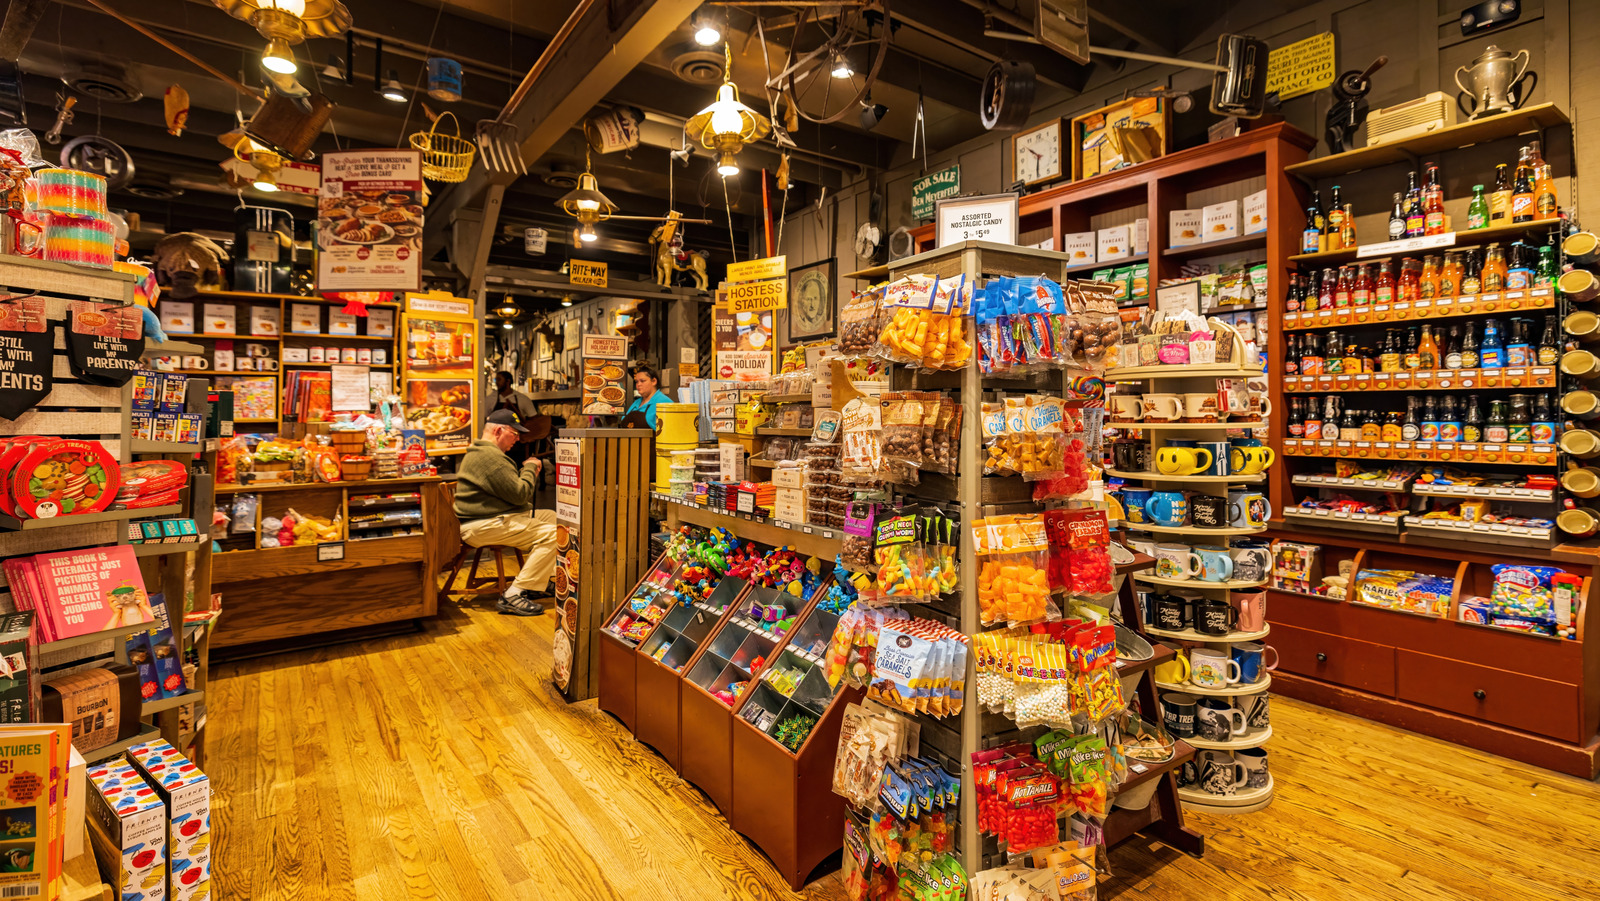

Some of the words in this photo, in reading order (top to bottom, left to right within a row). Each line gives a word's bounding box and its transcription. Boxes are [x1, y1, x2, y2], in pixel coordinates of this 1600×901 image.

[1303, 47, 1331, 60] AGAINST
[1294, 55, 1332, 70] CRIPPLING
[1267, 62, 1332, 87] ARTFORD
[1316, 71, 1333, 82] CO
[912, 178, 932, 195] FOR
[932, 171, 957, 184] SALE
[961, 212, 992, 221] ASSORTED
[1207, 214, 1233, 222] PANCAKE
[950, 220, 982, 229] NOSTALGIC
[983, 218, 1003, 226] CANDY
[963, 231, 969, 239] 3
[571, 263, 607, 277] RITE-WAY
[572, 276, 593, 284] MILKER
[730, 282, 783, 300] HOSTESS
[734, 296, 779, 312] STATION
[93, 341, 108, 350] LIVE
[110, 343, 128, 352] WITH
[103, 336, 122, 344] STILL
[7, 349, 33, 362] WITH
[105, 350, 117, 358] MY
[86, 356, 136, 370] PARENTS
[734, 359, 766, 369] HOLIDAY
[844, 408, 858, 418] COW
[1035, 404, 1060, 417] Vanilla
[1031, 412, 1063, 431] CARAMELS
[46, 443, 66, 452] DOG
[67, 442, 91, 451] TREATS
[404, 462, 429, 473] DOTS
[881, 522, 895, 533] SOUR
[897, 520, 912, 528] NEON
[1069, 519, 1104, 530] CINNAMON
[1075, 526, 1102, 537] BEARS
[48, 557, 71, 567] THIS
[72, 553, 97, 564] BOOK
[98, 552, 108, 561] IS
[52, 563, 98, 577] LITERALLY
[100, 560, 121, 570] JUST
[54, 572, 98, 587] PICTURES
[99, 571, 111, 580] OF
[57, 582, 100, 596] ANIMALS
[59, 591, 101, 605] SILENTLY
[63, 601, 103, 616] JUDGING
[64, 614, 85, 625] YOU
[884, 651, 896, 661] SEA
[897, 654, 911, 666] SALT
[876, 657, 912, 679] CARAMELS
[77, 698, 108, 715] BOURBON
[1179, 714, 1195, 724] TREK
[1072, 752, 1091, 765] Mike
[1092, 750, 1105, 760] Ike
[1011, 786, 1027, 801] HOT
[176, 800, 192, 808] COFFEE
[191, 796, 206, 805] HOUSE
[190, 798, 207, 808] SAMPLER
[128, 829, 144, 838] COFFEE
[144, 824, 161, 833] HOUSE
[142, 827, 162, 836] SAMPLER
[924, 873, 939, 891] Ike
